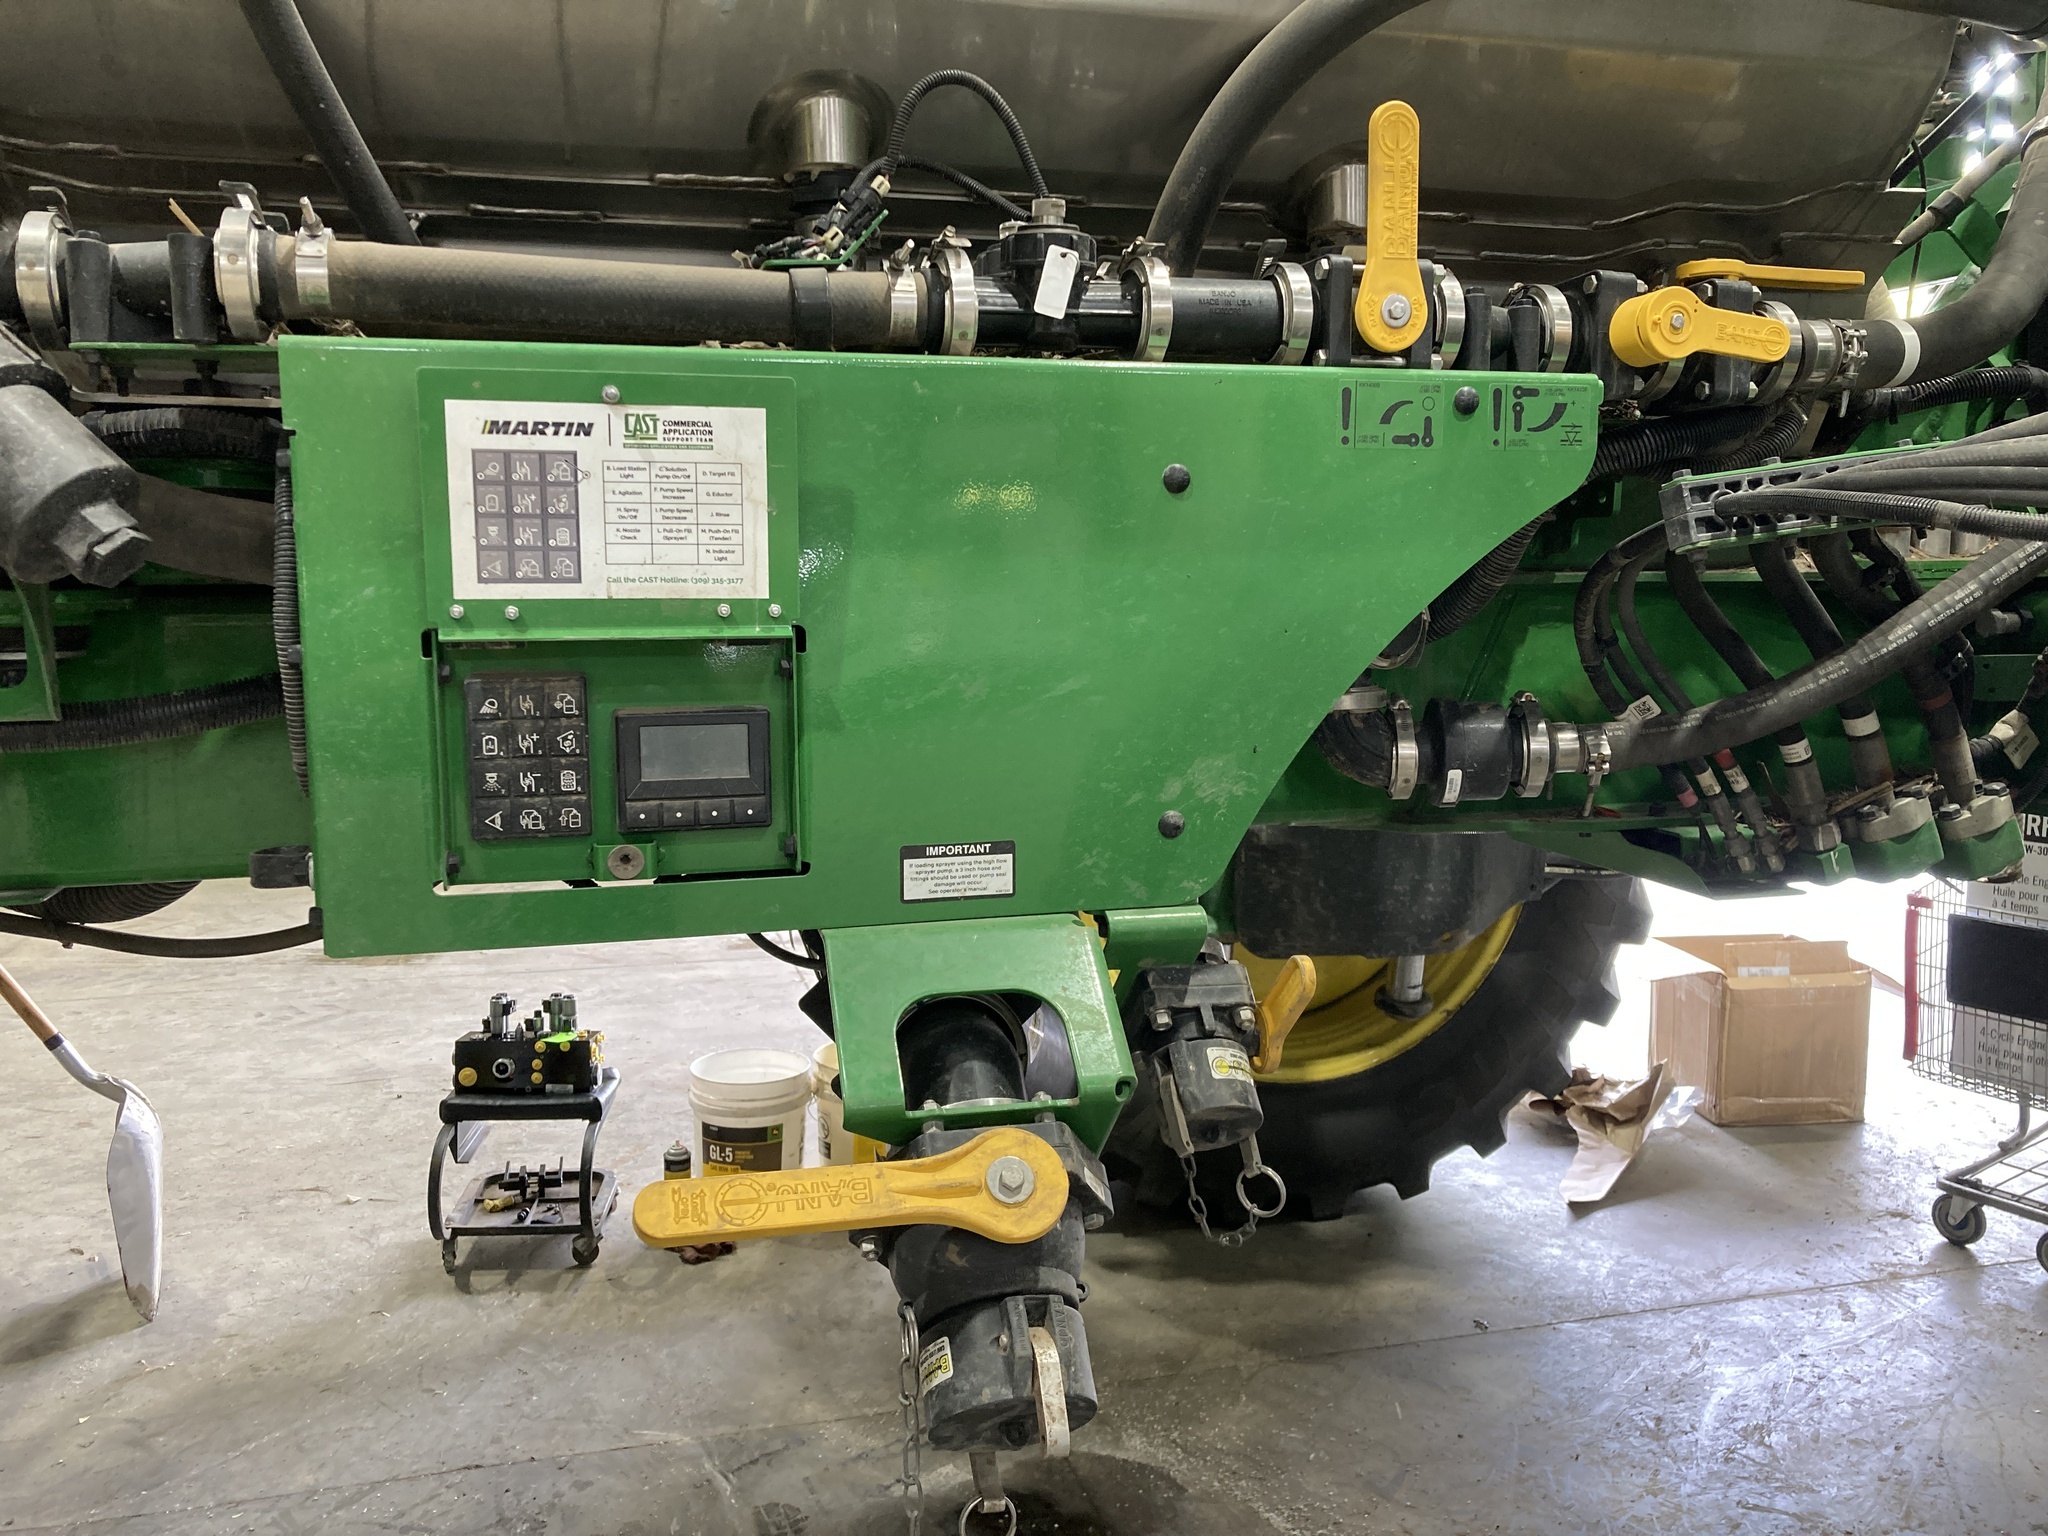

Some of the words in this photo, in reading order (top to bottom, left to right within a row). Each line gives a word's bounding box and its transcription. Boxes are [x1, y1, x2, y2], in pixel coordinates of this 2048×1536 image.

[486, 420, 595, 437] MARTIN
[624, 413, 660, 438] CAST
[662, 420, 713, 428] COMMERCIAL
[662, 428, 713, 436] APPLICATION
[607, 576, 623, 584] Call
[624, 576, 637, 584] the
[638, 576, 658, 584] CAST
[660, 576, 690, 584] Hotline:
[691, 576, 710, 585] (309)
[711, 577, 744, 586] 315-3177
[926, 844, 992, 857] IMPORTANT
[1993, 885, 2016, 898] Huile
[2019, 891, 2040, 901] pour
[2001, 899, 2007, 909] 4
[2011, 901, 2039, 915] temps
[710, 1144, 733, 1163] GL-5
